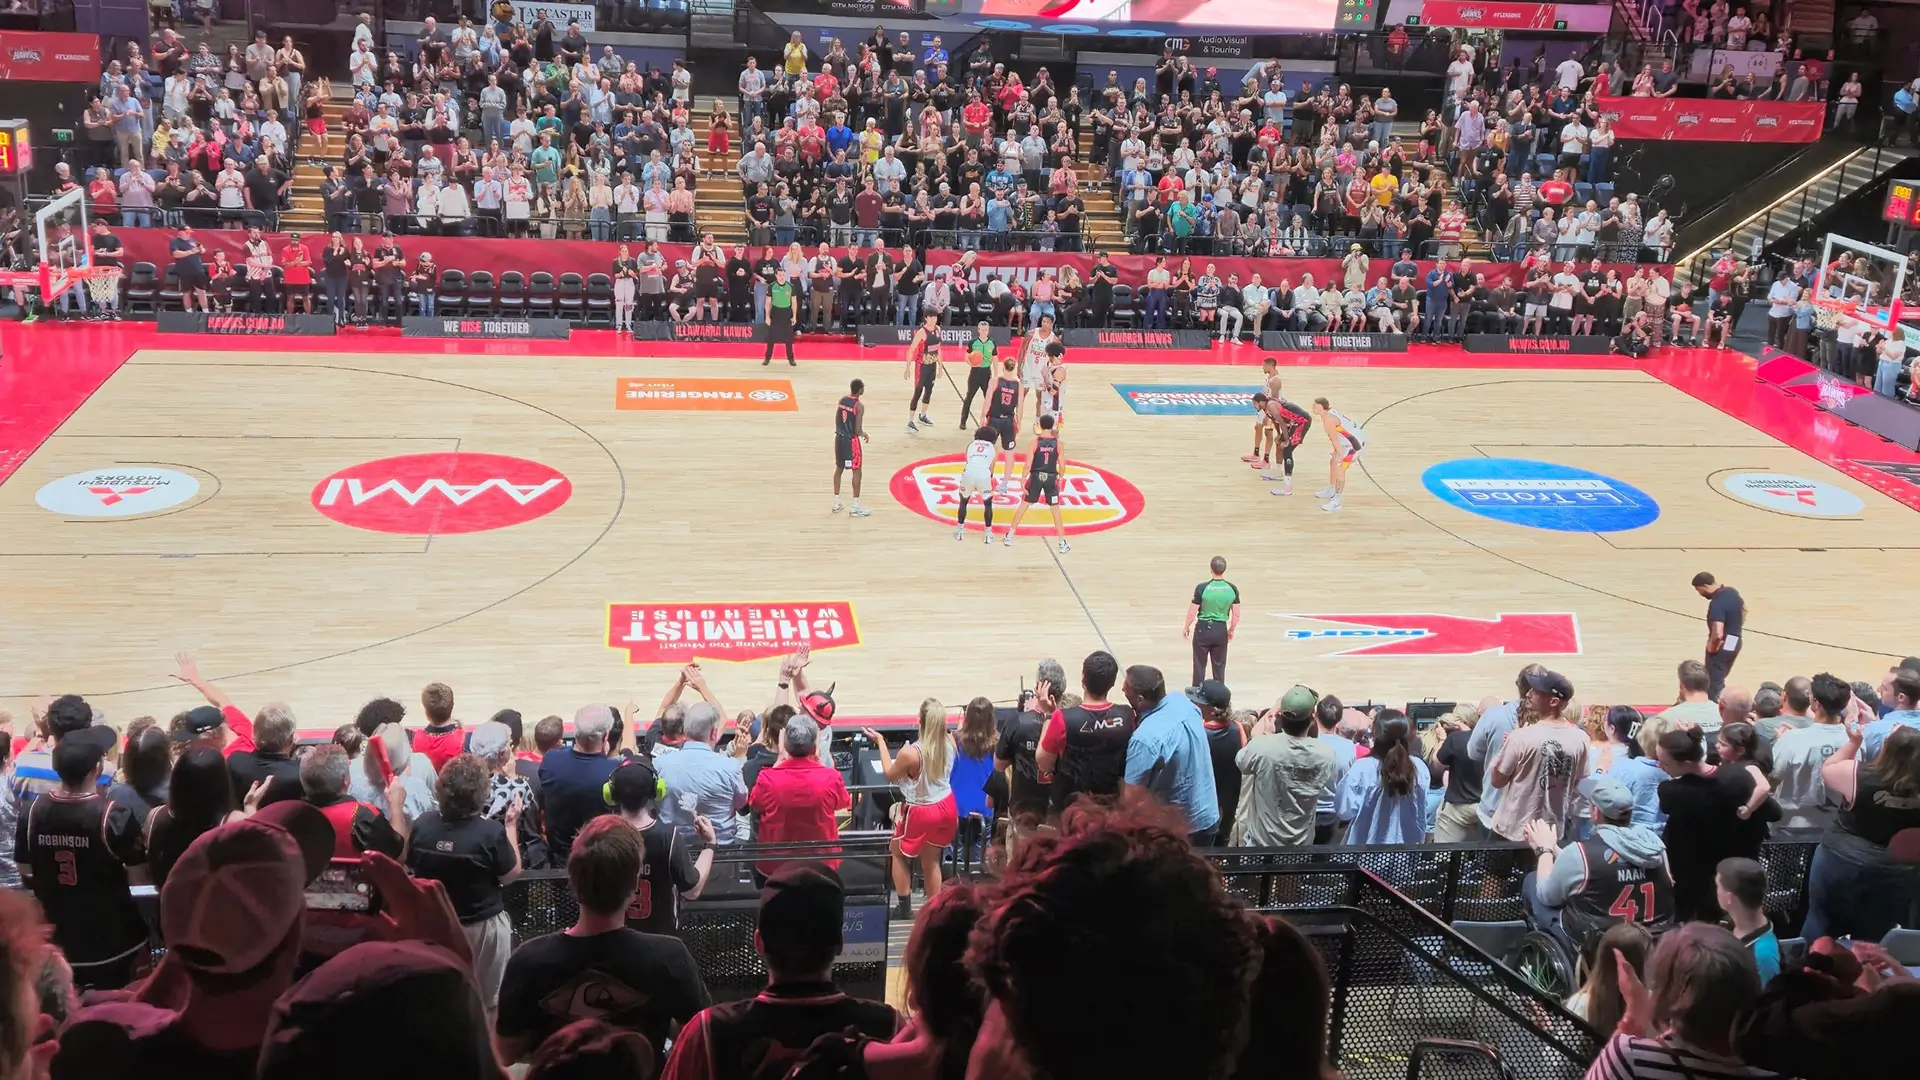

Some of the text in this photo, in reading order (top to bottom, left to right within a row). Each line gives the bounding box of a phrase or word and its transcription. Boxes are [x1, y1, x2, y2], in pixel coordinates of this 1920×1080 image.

[1225, 36, 1247, 44] Visual
[1211, 46, 1241, 55] Touring
[444, 320, 529, 334] WE RISE TOGETHER
[676, 325, 752, 338] ILLAWARRA HAWKS
[898, 329, 912, 341] WE
[1099, 332, 1172, 344] ILLAWARRA HAWKS
[1300, 336, 1312, 347] WE
[1332, 336, 1371, 347] TOGETHER
[626, 390, 744, 399] TANGERINE
[1133, 397, 1253, 405] UNNINGS
[319, 478, 565, 506] AAMI
[1469, 490, 1623, 504] La Trobe
[631, 608, 839, 620] WAREHOUSE
[622, 619, 844, 641] CHEMIST
[660, 641, 705, 649] Much!!
[735, 641, 780, 649] Paying
[38, 834, 89, 848] ROBINSON
[54, 850, 78, 886] 3
[1608, 881, 1655, 924] 41
